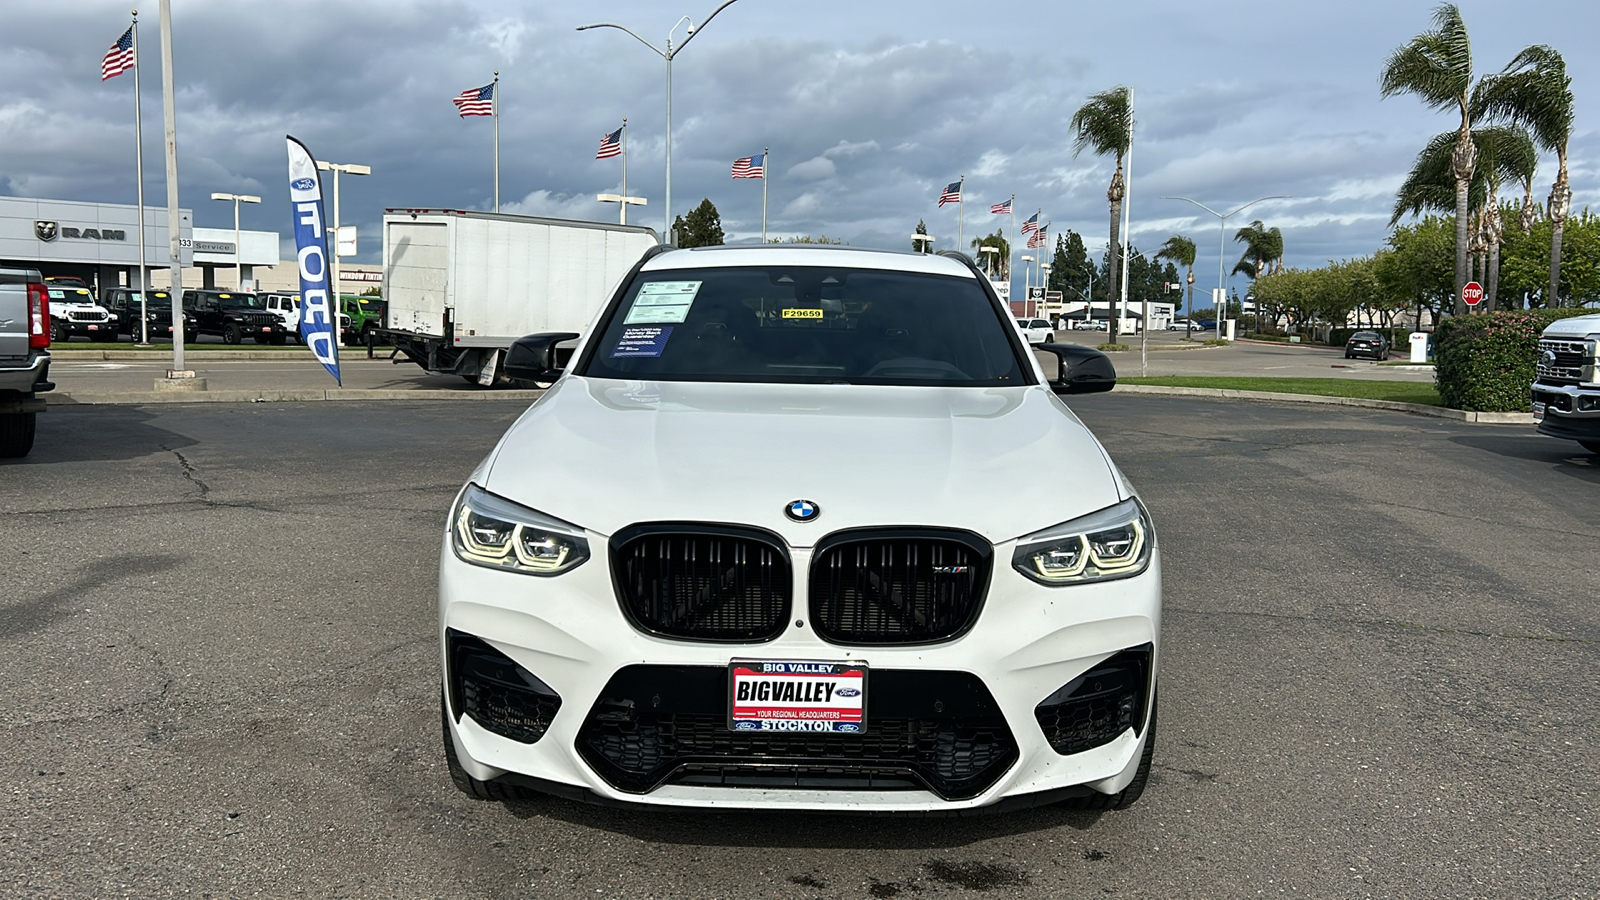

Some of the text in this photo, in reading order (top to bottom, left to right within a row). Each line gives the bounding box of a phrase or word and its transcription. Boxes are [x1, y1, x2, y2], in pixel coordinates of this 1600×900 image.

[61, 227, 125, 241] RAM
[195, 242, 230, 250] Service
[340, 271, 365, 280] WINDOW
[1464, 289, 1482, 298] STOP
[763, 663, 834, 673] BIG VALLEY
[736, 681, 836, 702] BIGVALLEY
[799, 711, 840, 719] HEADQUARTERS
[761, 720, 834, 731] STOCKTON
